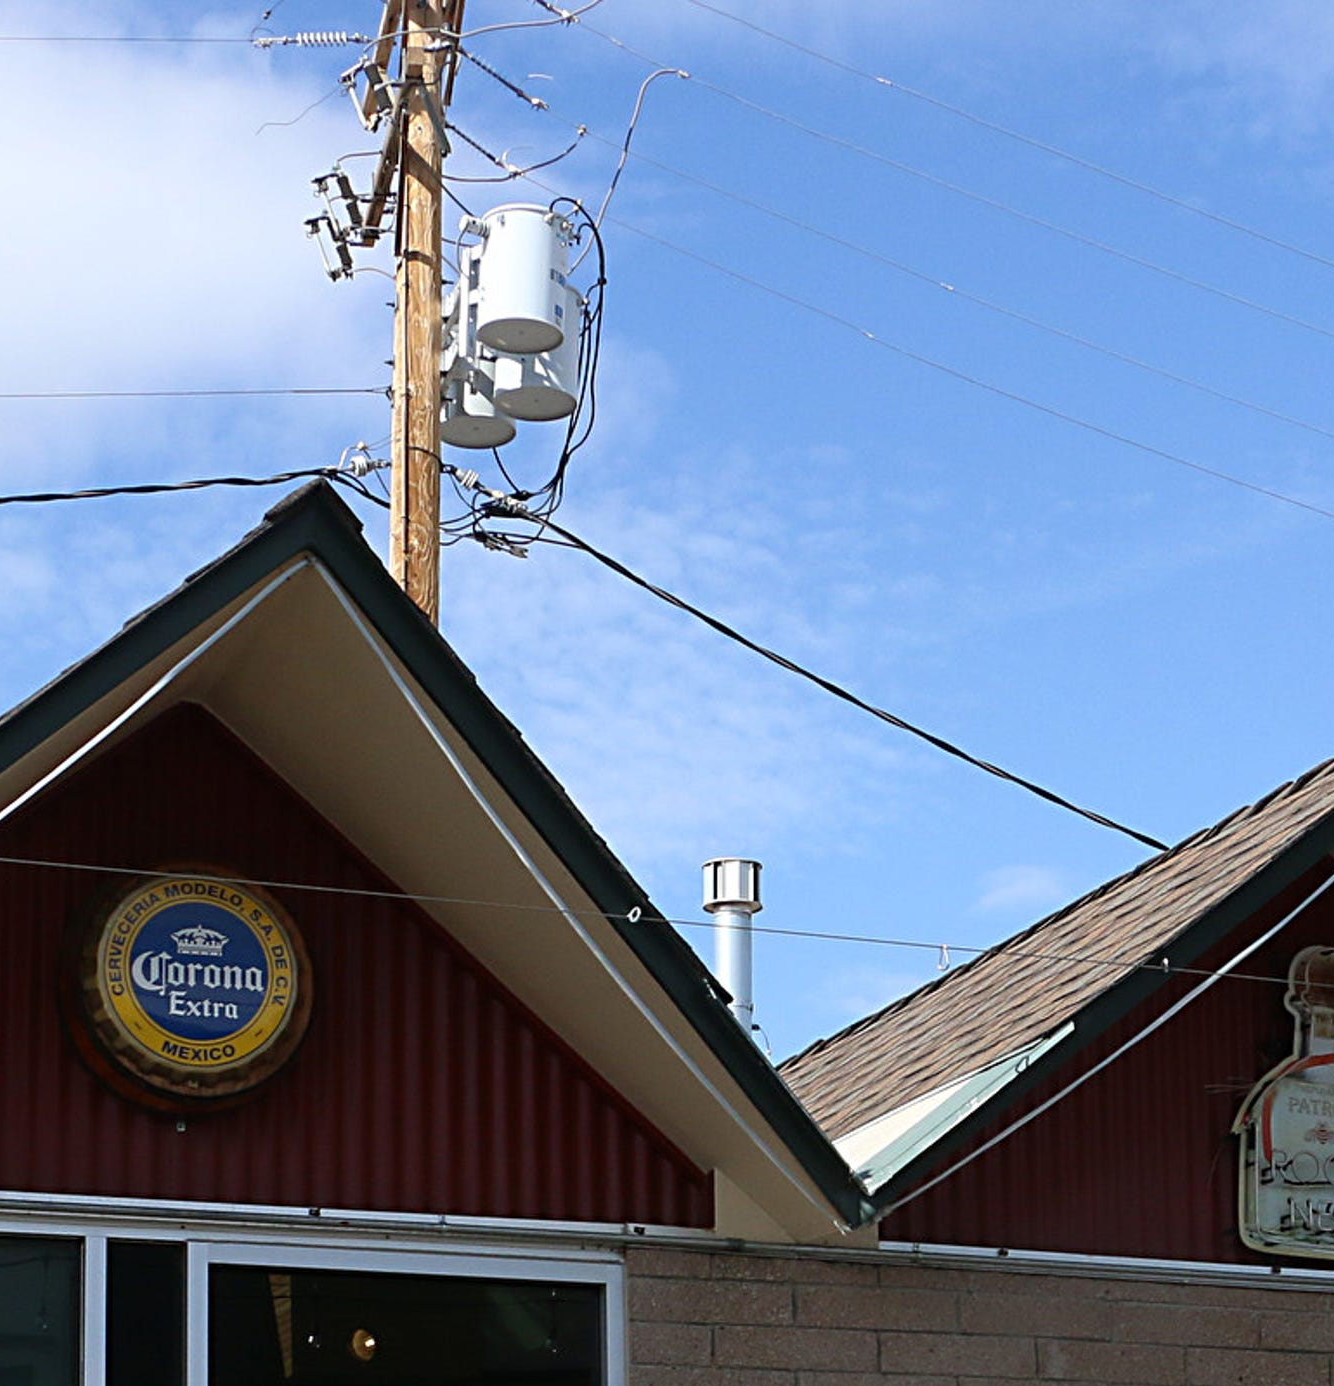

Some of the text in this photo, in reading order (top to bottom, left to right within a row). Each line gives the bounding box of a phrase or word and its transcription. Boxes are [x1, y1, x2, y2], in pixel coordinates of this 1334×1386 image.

[108, 893, 161, 996] CERVECERIA
[163, 882, 246, 912] MODELO,
[249, 908, 276, 942] S.A.
[271, 945, 288, 970] DE
[131, 950, 265, 997] Corona
[169, 990, 240, 1020] Extra
[161, 1041, 236, 1062] MEXICO
